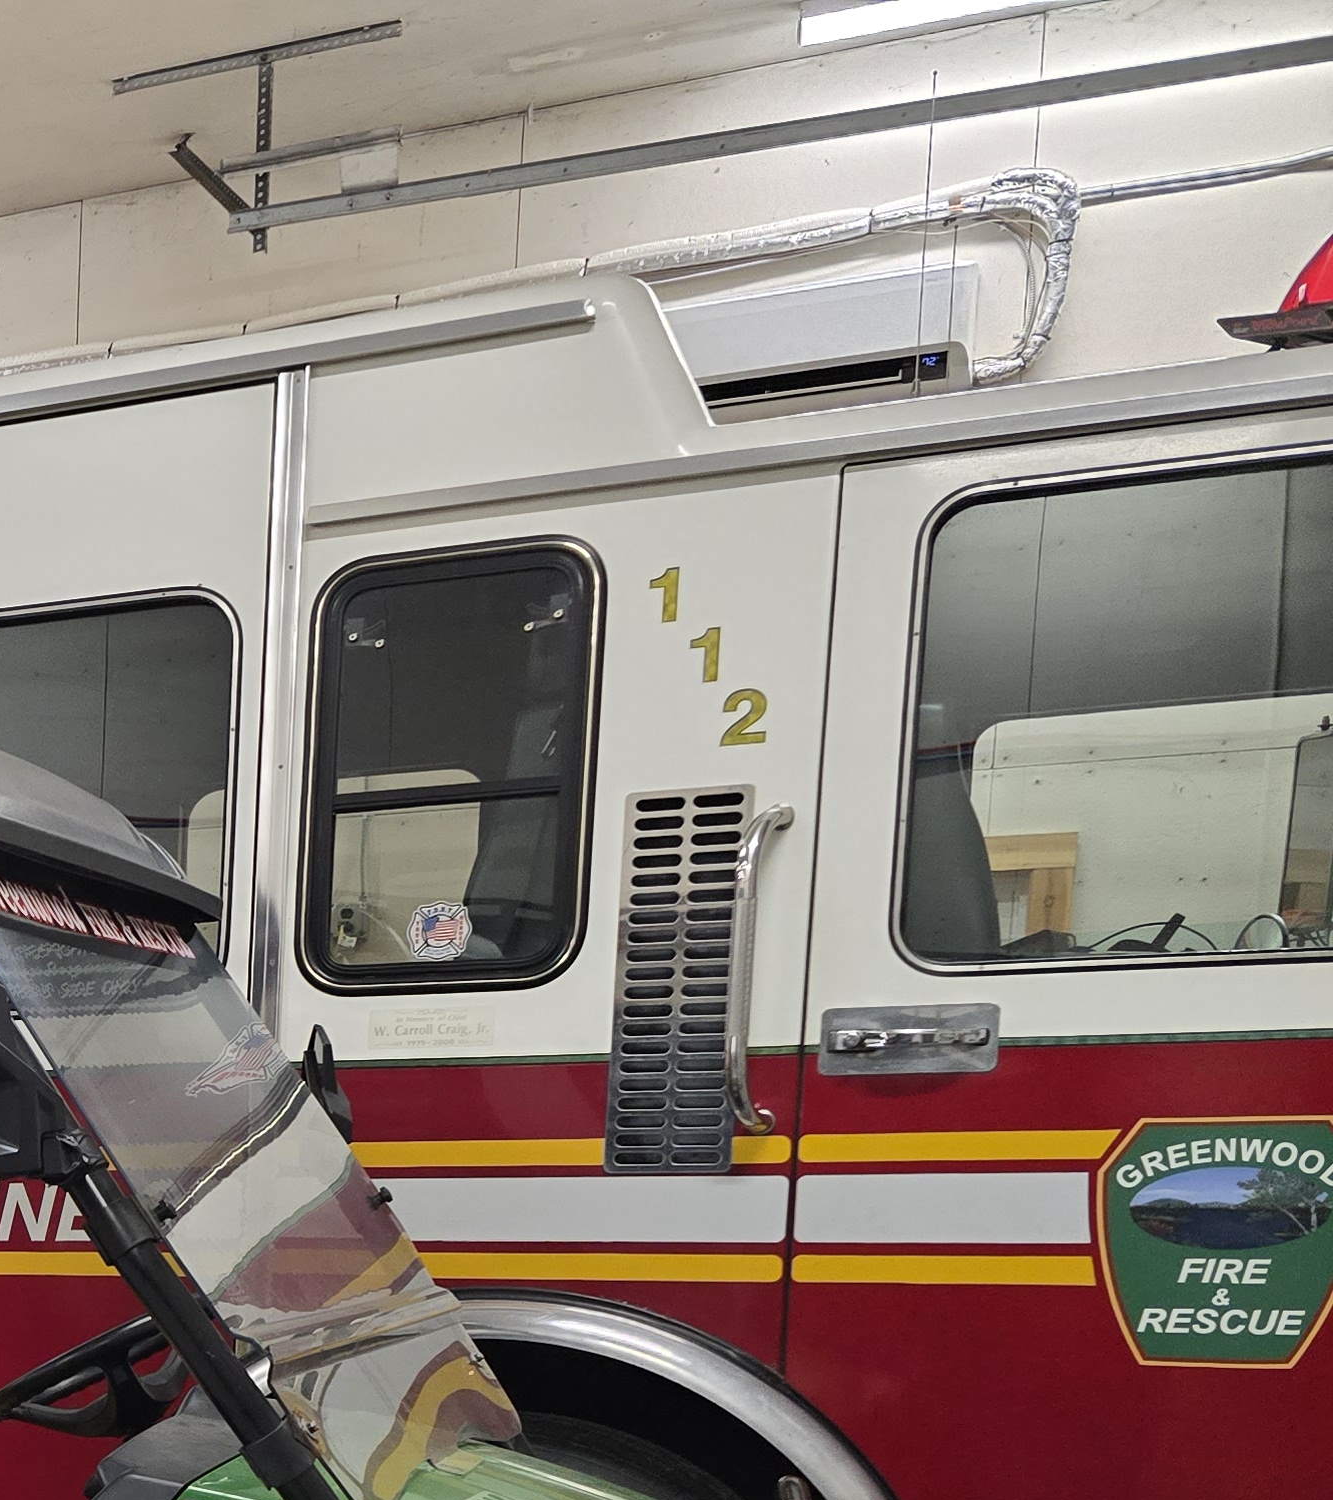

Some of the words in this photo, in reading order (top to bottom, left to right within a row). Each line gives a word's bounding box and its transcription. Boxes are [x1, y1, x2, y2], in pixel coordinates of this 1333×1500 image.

[77, 901, 130, 945] FIRE
[374, 1026, 390, 1037] W.
[394, 1024, 433, 1036] Carroll
[437, 1023, 473, 1037] Craig,
[476, 1022, 490, 1035] Jr.
[1177, 1258, 1272, 1285] FIRE
[1211, 1288, 1230, 1306] &
[1136, 1308, 1306, 1336] RESCUE
